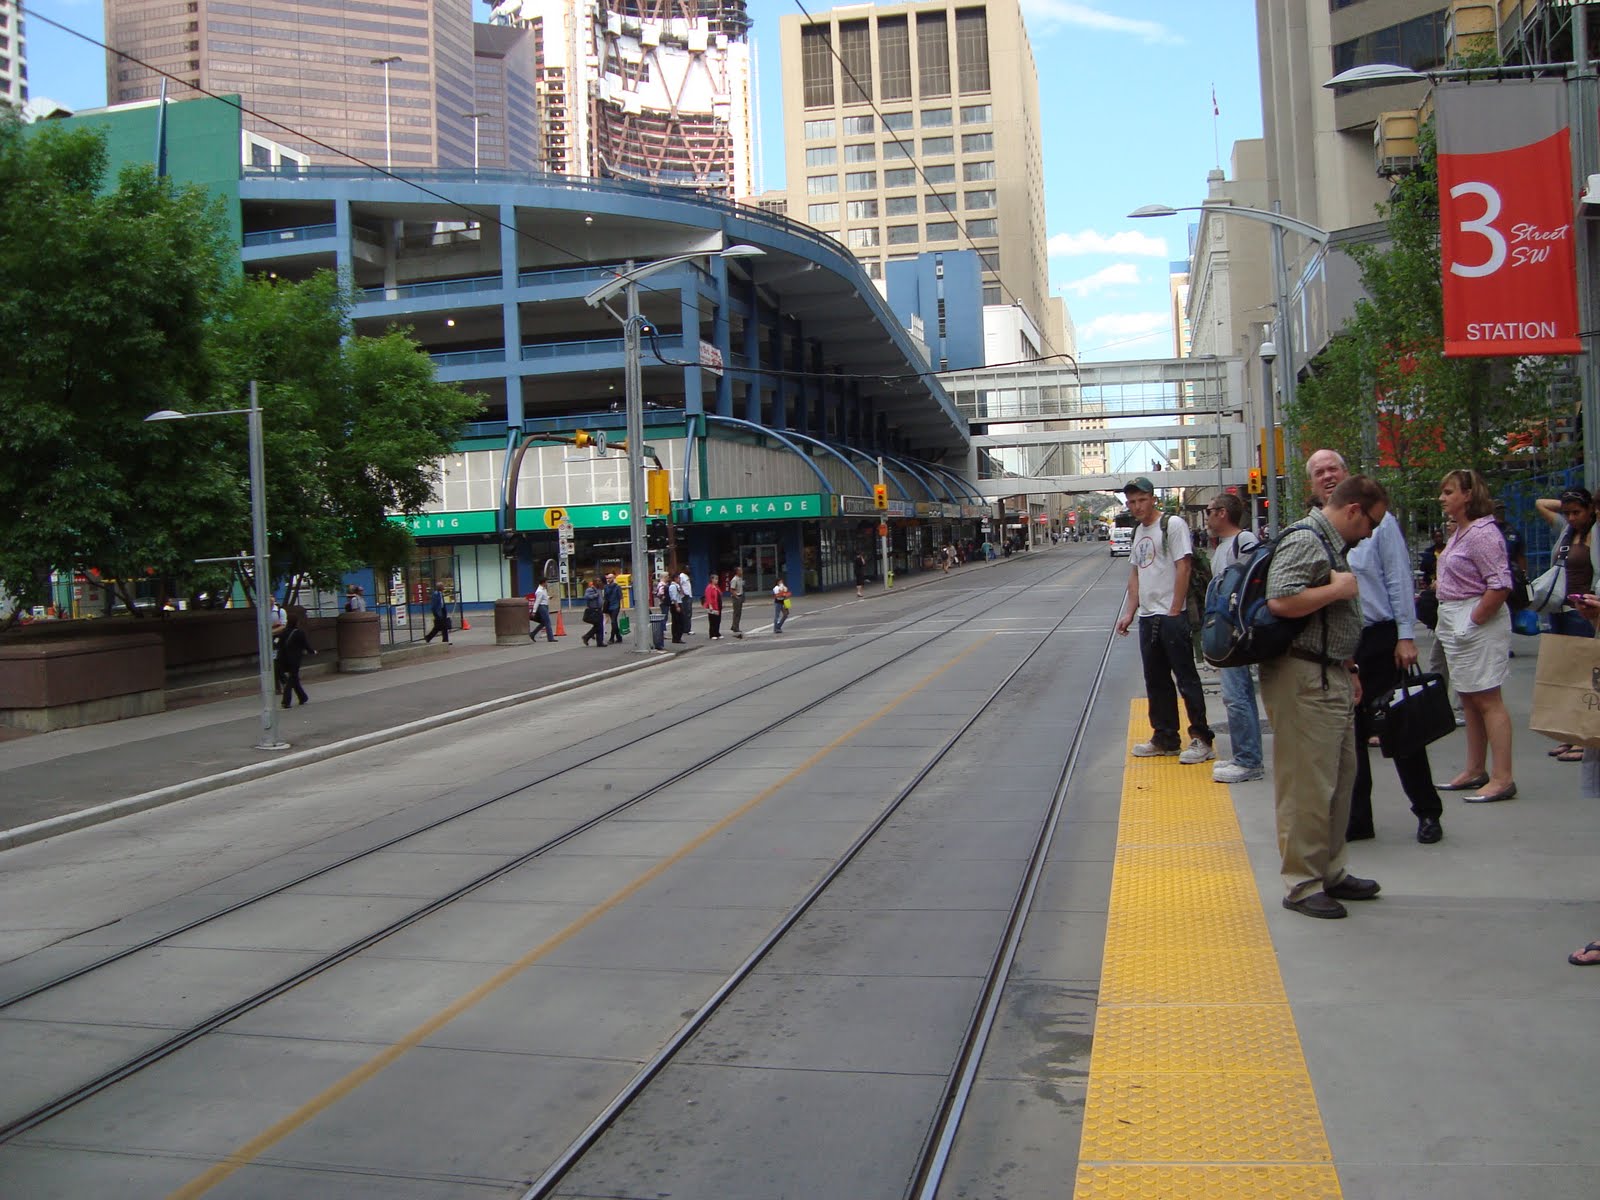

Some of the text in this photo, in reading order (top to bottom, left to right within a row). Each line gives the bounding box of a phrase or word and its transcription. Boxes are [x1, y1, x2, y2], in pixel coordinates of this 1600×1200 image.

[1449, 181, 1507, 278] 3
[1510, 223, 1570, 244] Street
[1511, 246, 1553, 267] SW
[1466, 321, 1556, 341] STATION
[602, 509, 629, 521] BO
[705, 500, 808, 515] PARKADE
[551, 509, 563, 527] P
